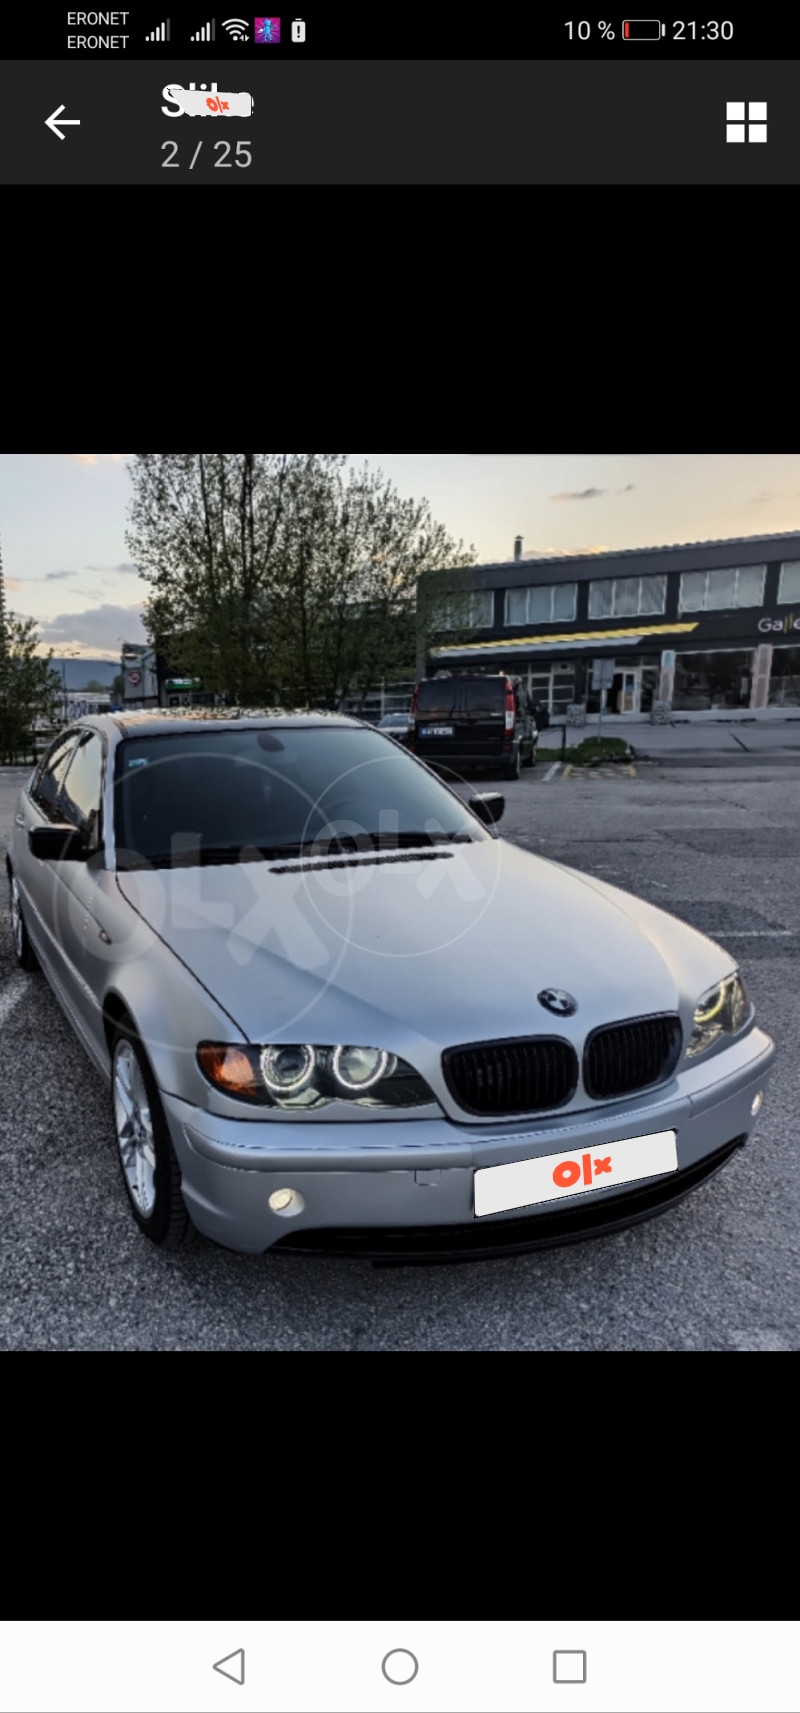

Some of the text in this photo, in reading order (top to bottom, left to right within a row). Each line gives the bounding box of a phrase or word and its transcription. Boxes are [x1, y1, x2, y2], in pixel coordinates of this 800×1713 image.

[68, 12, 129, 25] ERONET
[565, 20, 615, 40] 10 %
[673, 21, 734, 40] 21:30
[68, 35, 129, 49] ERONET
[161, 141, 179, 167] 2
[213, 141, 252, 167] 25
